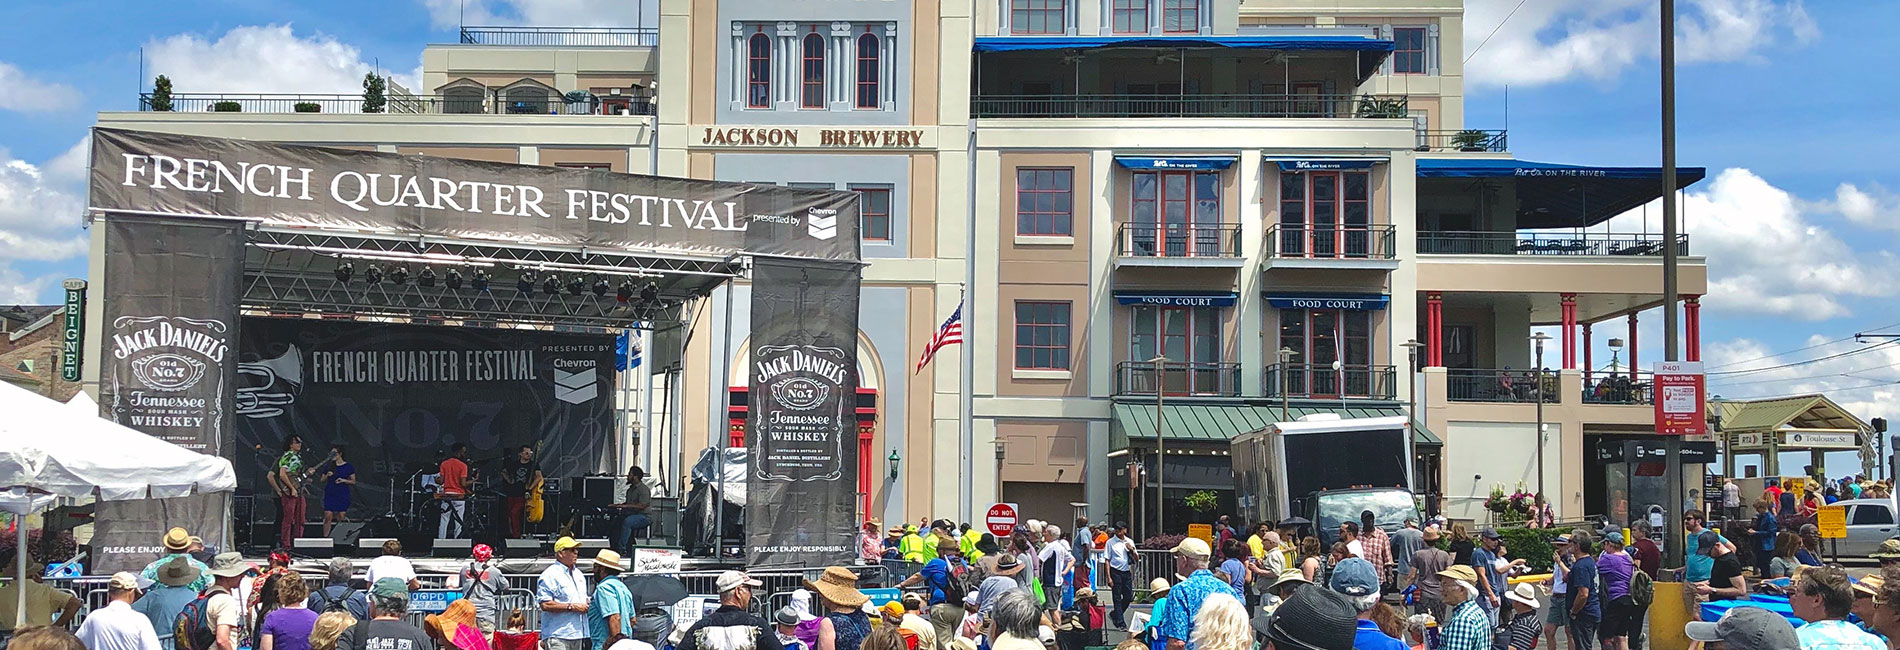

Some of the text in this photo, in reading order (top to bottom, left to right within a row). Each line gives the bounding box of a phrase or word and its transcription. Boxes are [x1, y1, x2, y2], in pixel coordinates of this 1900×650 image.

[702, 127, 924, 147] JACKSON BREWERY
[1579, 169, 1606, 177] RIVER
[121, 152, 748, 232] FRENCH QUARTER FESTIVAL
[808, 206, 837, 215] Chevron
[753, 213, 801, 227] presented by
[1175, 298, 1212, 306] COURT
[1292, 300, 1363, 309] FOOD COURT
[64, 291, 79, 378] BEIGNET
[112, 321, 229, 368] JACK DANIEL'S
[542, 344, 610, 352] PRESENTED BY
[313, 349, 537, 385] FRENCH QUARTER FESTIVAL
[554, 357, 597, 369] Chevron
[756, 349, 848, 388] JACK DANIEL'S
[152, 367, 186, 378] No.7
[130, 391, 206, 408] Tennessee
[787, 390, 814, 399] No.7
[131, 416, 204, 427] WHISKEY
[770, 411, 830, 425] Tennessee
[771, 432, 829, 441] WHISKEY
[1806, 435, 1836, 443] Toulouse
[676, 600, 698, 608] GET
[676, 609, 698, 618] THE
